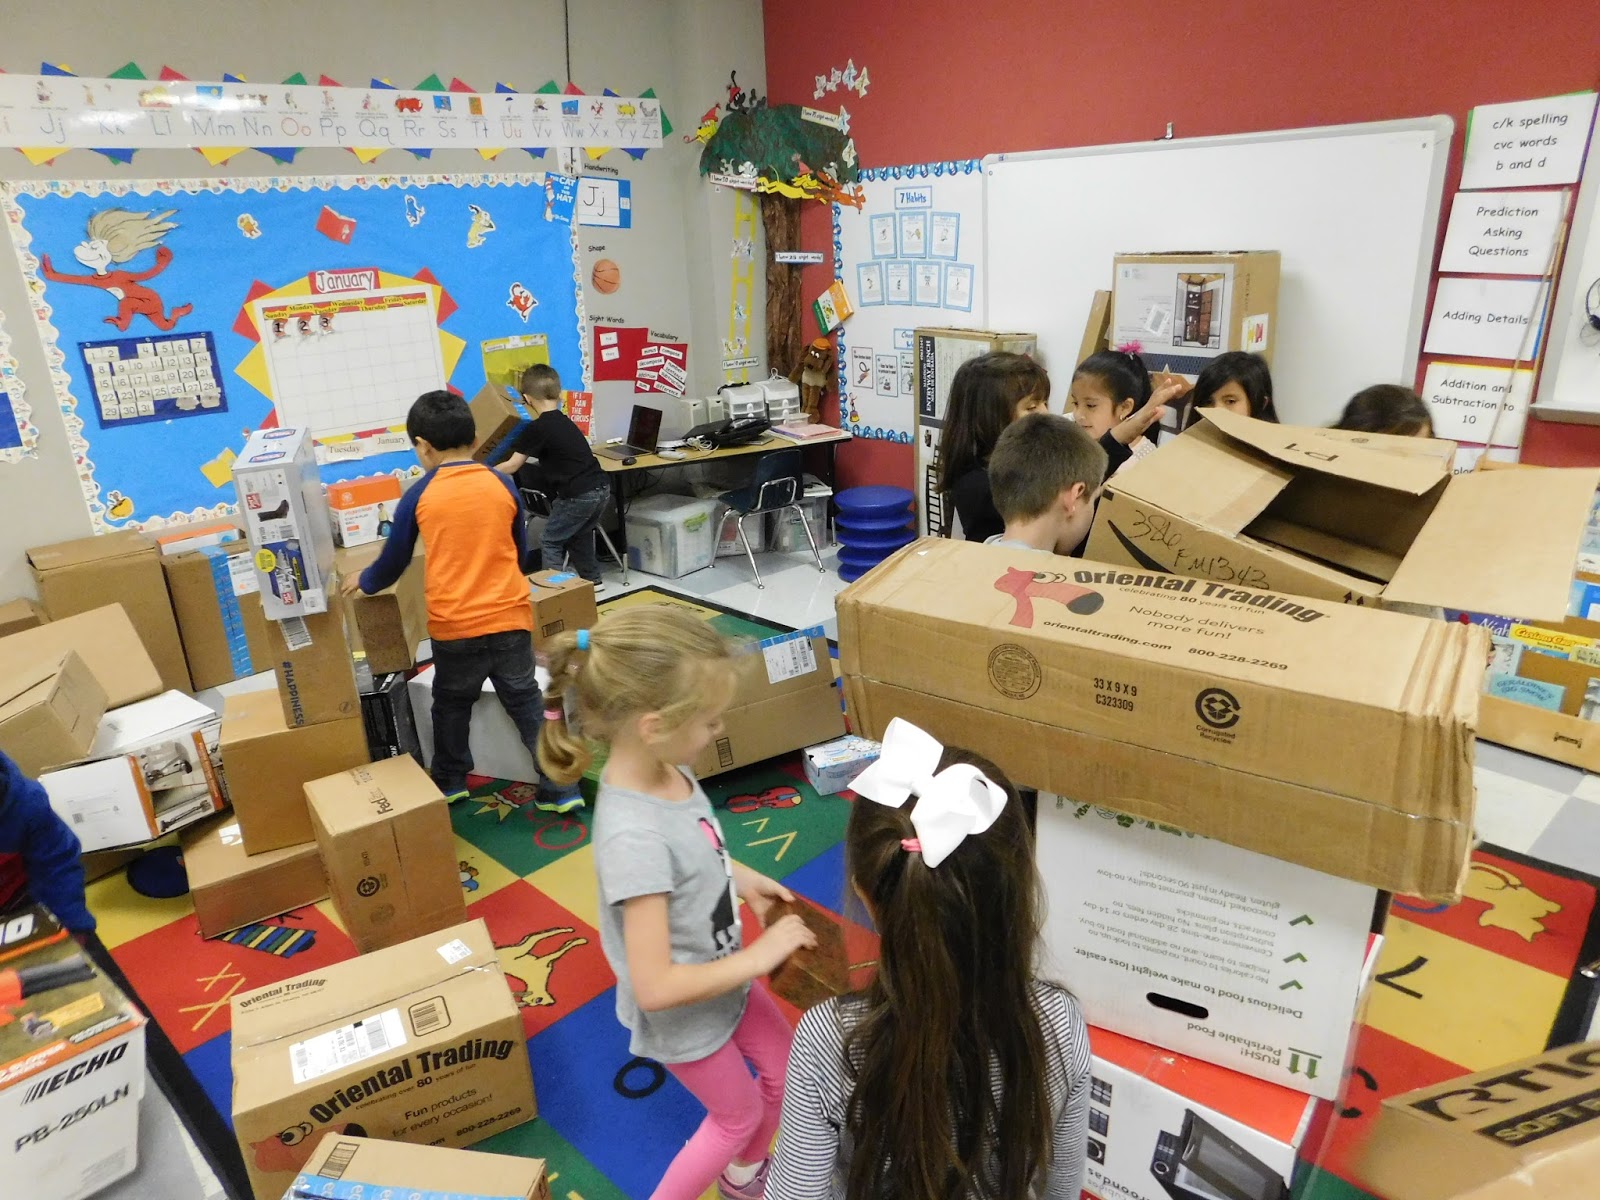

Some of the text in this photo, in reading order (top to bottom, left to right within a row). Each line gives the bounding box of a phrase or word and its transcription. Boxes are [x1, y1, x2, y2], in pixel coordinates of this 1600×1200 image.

[1493, 113, 1568, 129] c/k spelling
[1494, 136, 1557, 150] cvc words
[584, 163, 618, 175] Handwriting
[1496, 157, 1546, 170] b and d
[560, 177, 576, 186] CAT
[556, 193, 573, 203] HAT
[900, 192, 927, 203] 7 Habits
[1476, 206, 1538, 217] Prediction
[1483, 228, 1522, 240] Asking
[1469, 246, 1529, 257] Questions
[317, 272, 372, 290] January
[300, 318, 329, 331] 2 3
[589, 315, 624, 324] Sight Words
[1443, 311, 1529, 325] Adding Details
[651, 330, 678, 342] Vocabulary
[134, 362, 143, 370] 10
[100, 380, 109, 388] 15
[133, 376, 142, 384] 17
[183, 370, 193, 378] 20
[1440, 379, 1513, 393] Addition and
[102, 394, 114, 402] 22
[155, 388, 166, 396] 25
[171, 386, 182, 394] 26
[106, 404, 150, 415] 29 30 31
[1432, 395, 1514, 411] Subtraction to
[1462, 415, 1476, 424] 10
[330, 446, 360, 454] Tuesday
[1074, 570, 1325, 622] Oriental Trading
[1119, 586, 1177, 602] celebrating
[1180, 595, 1197, 603] 80
[1200, 600, 1227, 609] years
[1246, 607, 1265, 615] fun
[1130, 606, 1265, 635] Nobody delivers
[1147, 621, 1232, 640] more fun!
[1515, 628, 1552, 643] Curious
[1044, 620, 1288, 671] orientaltrading.com 800-228-2269
[282, 660, 304, 725] #HAPPINESS
[1094, 677, 1137, 697] 33 X 9 X 9
[1095, 693, 1134, 711] C323309
[1196, 724, 1236, 740] Corrugated
[1200, 732, 1232, 745] Recycles
[1126, 875, 1194, 898] gourmet quality,
[1139, 870, 1246, 902] Ready just seconds!
[1083, 900, 1272, 956] Convenient one-time day orders day
[1107, 925, 1125, 935] food
[1125, 903, 1273, 948] subscription hidden fees,
[1128, 931, 1167, 946] additional
[1113, 936, 1253, 978] calories points look
[1238, 960, 1269, 974] recipes
[1072, 947, 1302, 1017] Delicious food to make weight loss easier.
[239, 986, 283, 1009] Oriental
[285, 978, 327, 994] Trading
[1186, 1022, 1281, 1055] Perishable Food
[1240, 1048, 1279, 1064] RUSH!
[44, 1041, 129, 1098] ECHO
[310, 1058, 413, 1124] Oriental
[416, 1038, 514, 1074] Trading
[355, 1092, 397, 1110] celebrating
[398, 1086, 415, 1095] over
[416, 1076, 433, 1088] 80
[435, 1071, 455, 1083] years
[404, 1088, 477, 1120] Fun products
[15, 1082, 130, 1154] PB-250LN
[392, 1093, 493, 1138] for every occasion!
[456, 1107, 521, 1137] 800-228-2269
